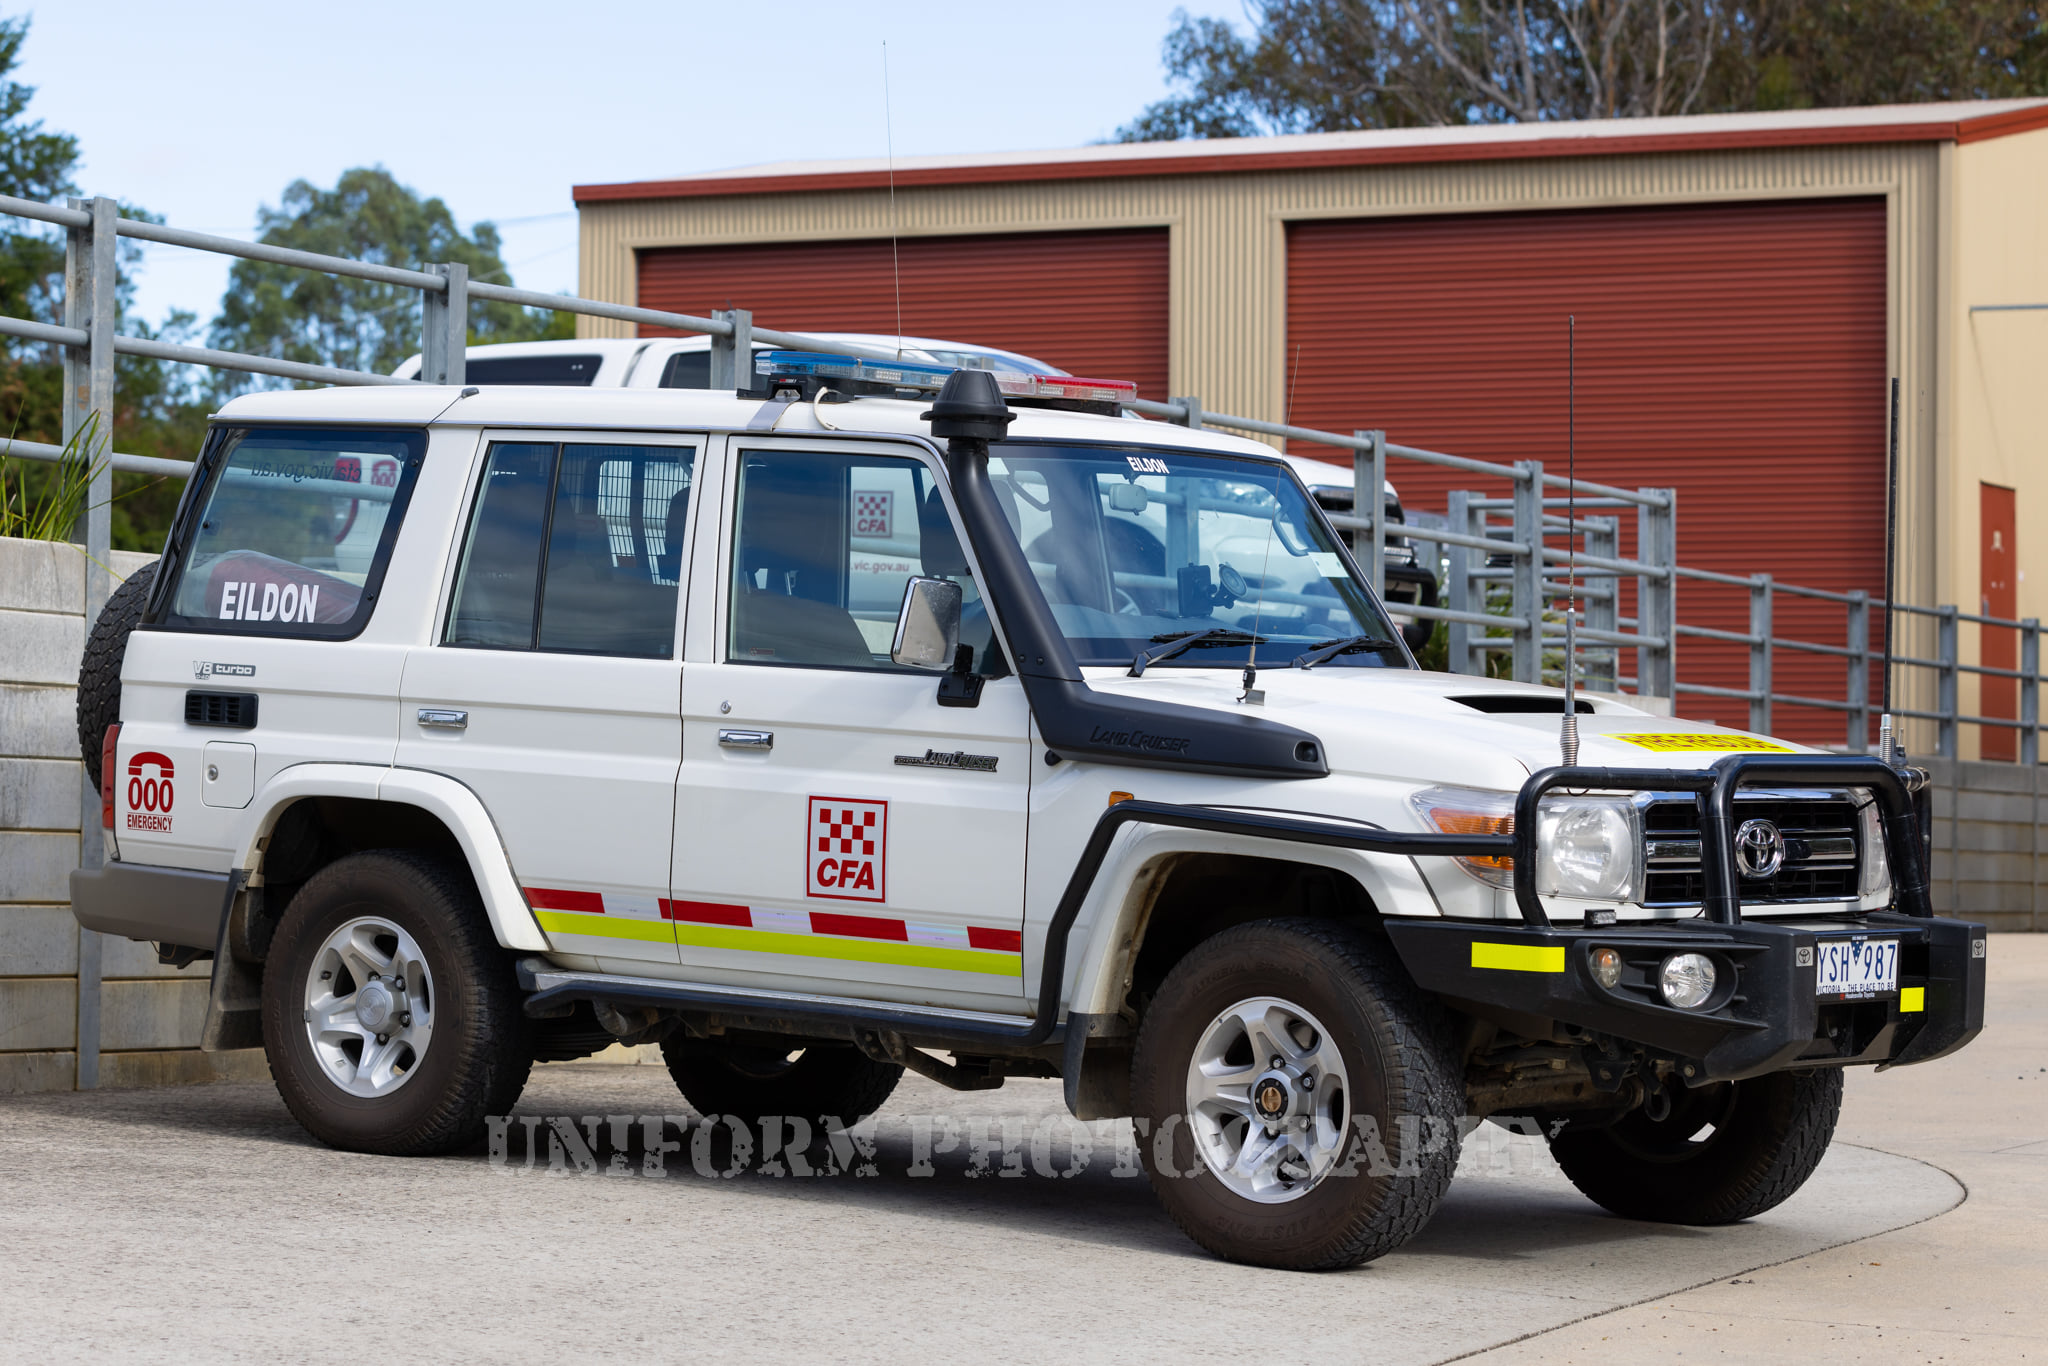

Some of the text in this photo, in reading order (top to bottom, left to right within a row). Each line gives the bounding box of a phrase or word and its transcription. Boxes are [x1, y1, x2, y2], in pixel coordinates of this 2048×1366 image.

[1126, 456, 1170, 474] EILDON
[857, 518, 887, 533] CFA
[219, 581, 320, 623] EILDON
[192, 660, 254, 675] V8 turbo
[128, 777, 174, 813] 000
[128, 814, 173, 831] EMERGENCY
[816, 858, 875, 891] CFA
[1818, 945, 1895, 982] YSH 987
[1817, 985, 1840, 994] VICTORIA
[1848, 983, 1857, 993] THE
[1860, 982, 1875, 992] PLACE
[1878, 982, 1884, 991] TO
